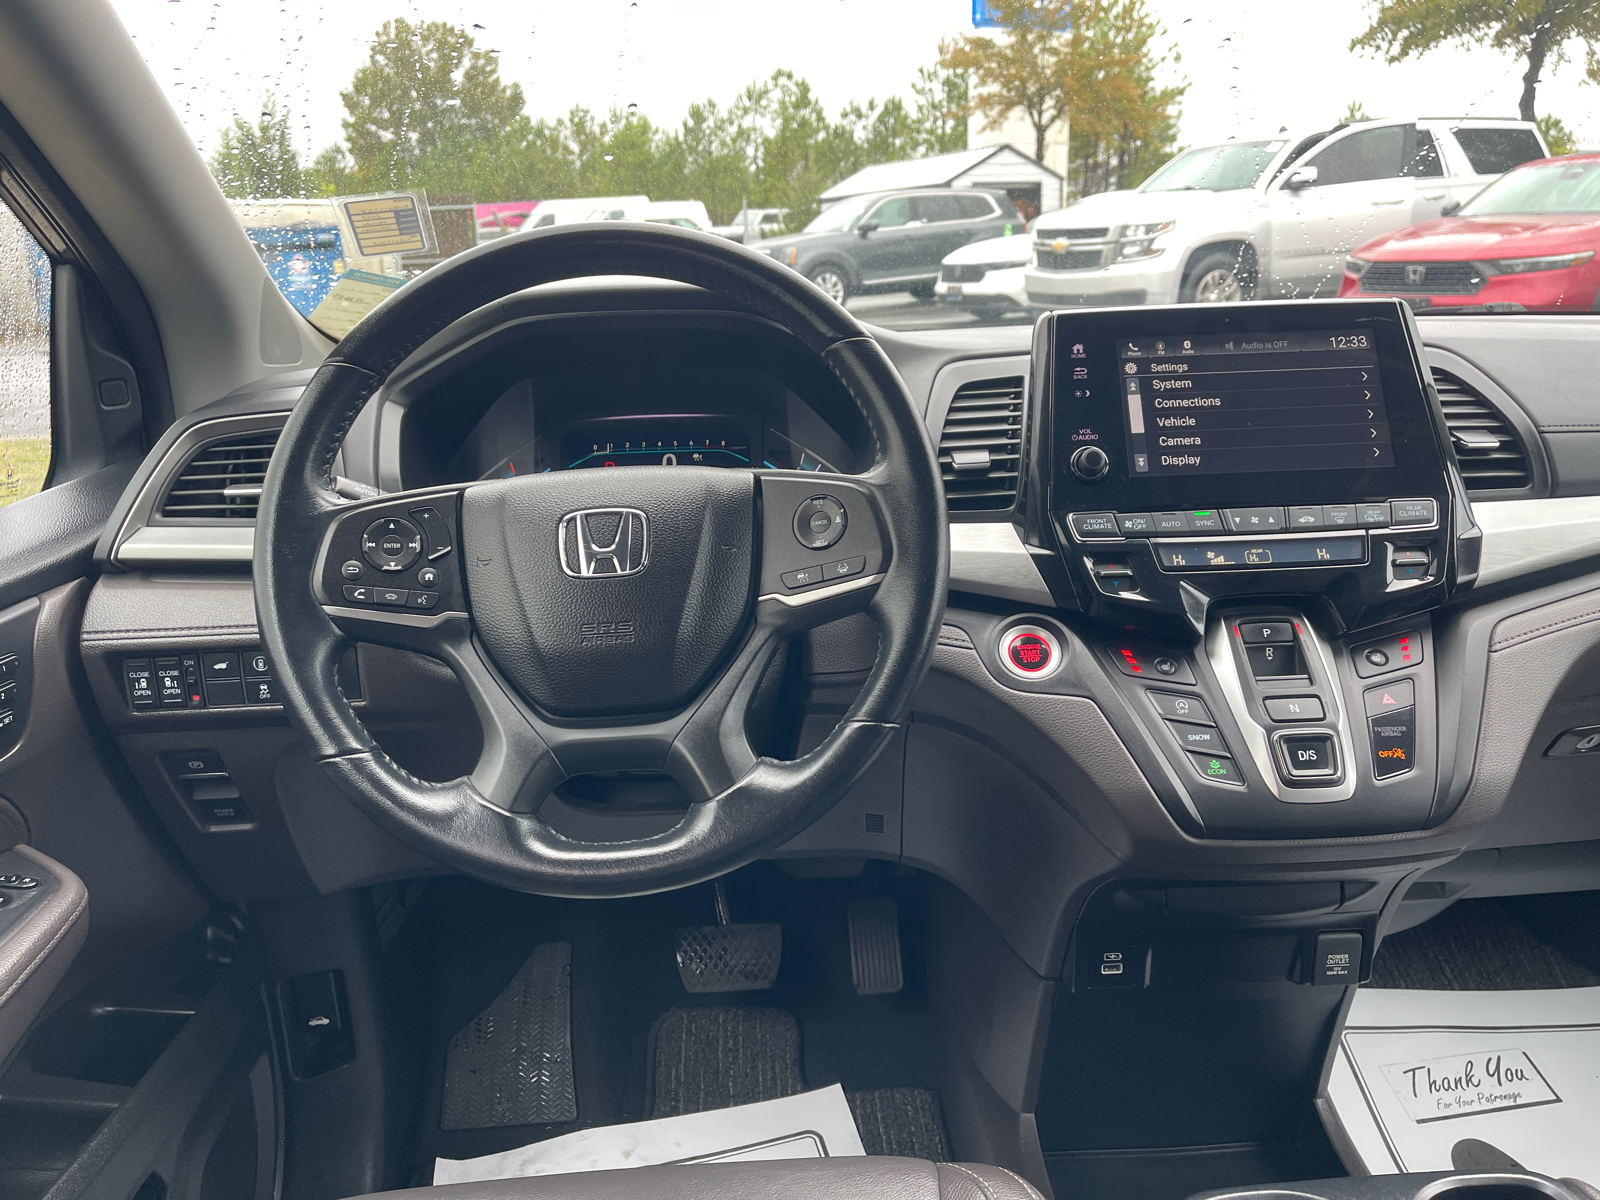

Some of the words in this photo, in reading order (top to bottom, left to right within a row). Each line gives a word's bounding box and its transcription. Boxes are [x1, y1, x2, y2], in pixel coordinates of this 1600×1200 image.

[1241, 340, 1261, 350] Audio
[1263, 340, 1272, 349] is
[1273, 340, 1289, 348] OFF
[1329, 335, 1368, 349] 12:33
[1151, 362, 1188, 373] Settings
[1152, 378, 1192, 391] System
[1155, 396, 1221, 408] Connections
[1156, 416, 1196, 427] Vehicle
[1159, 435, 1202, 447] Camera
[1161, 454, 1201, 466] Display
[354, 486, 374, 496] AUTO
[1161, 520, 1181, 528] AUTO
[1195, 519, 1215, 527] SYNC
[1263, 628, 1271, 638] P
[1265, 647, 1274, 658] R
[1289, 704, 1300, 713] N
[1298, 749, 1317, 762] D/S
[1378, 750, 1394, 758] OFF
[1207, 767, 1227, 776] ECON
[1402, 1059, 1481, 1098] Thank
[1485, 1054, 1530, 1088] You
[1436, 1098, 1453, 1110] For
[1454, 1095, 1476, 1108] Your
[1477, 1090, 1523, 1104] Patronage
